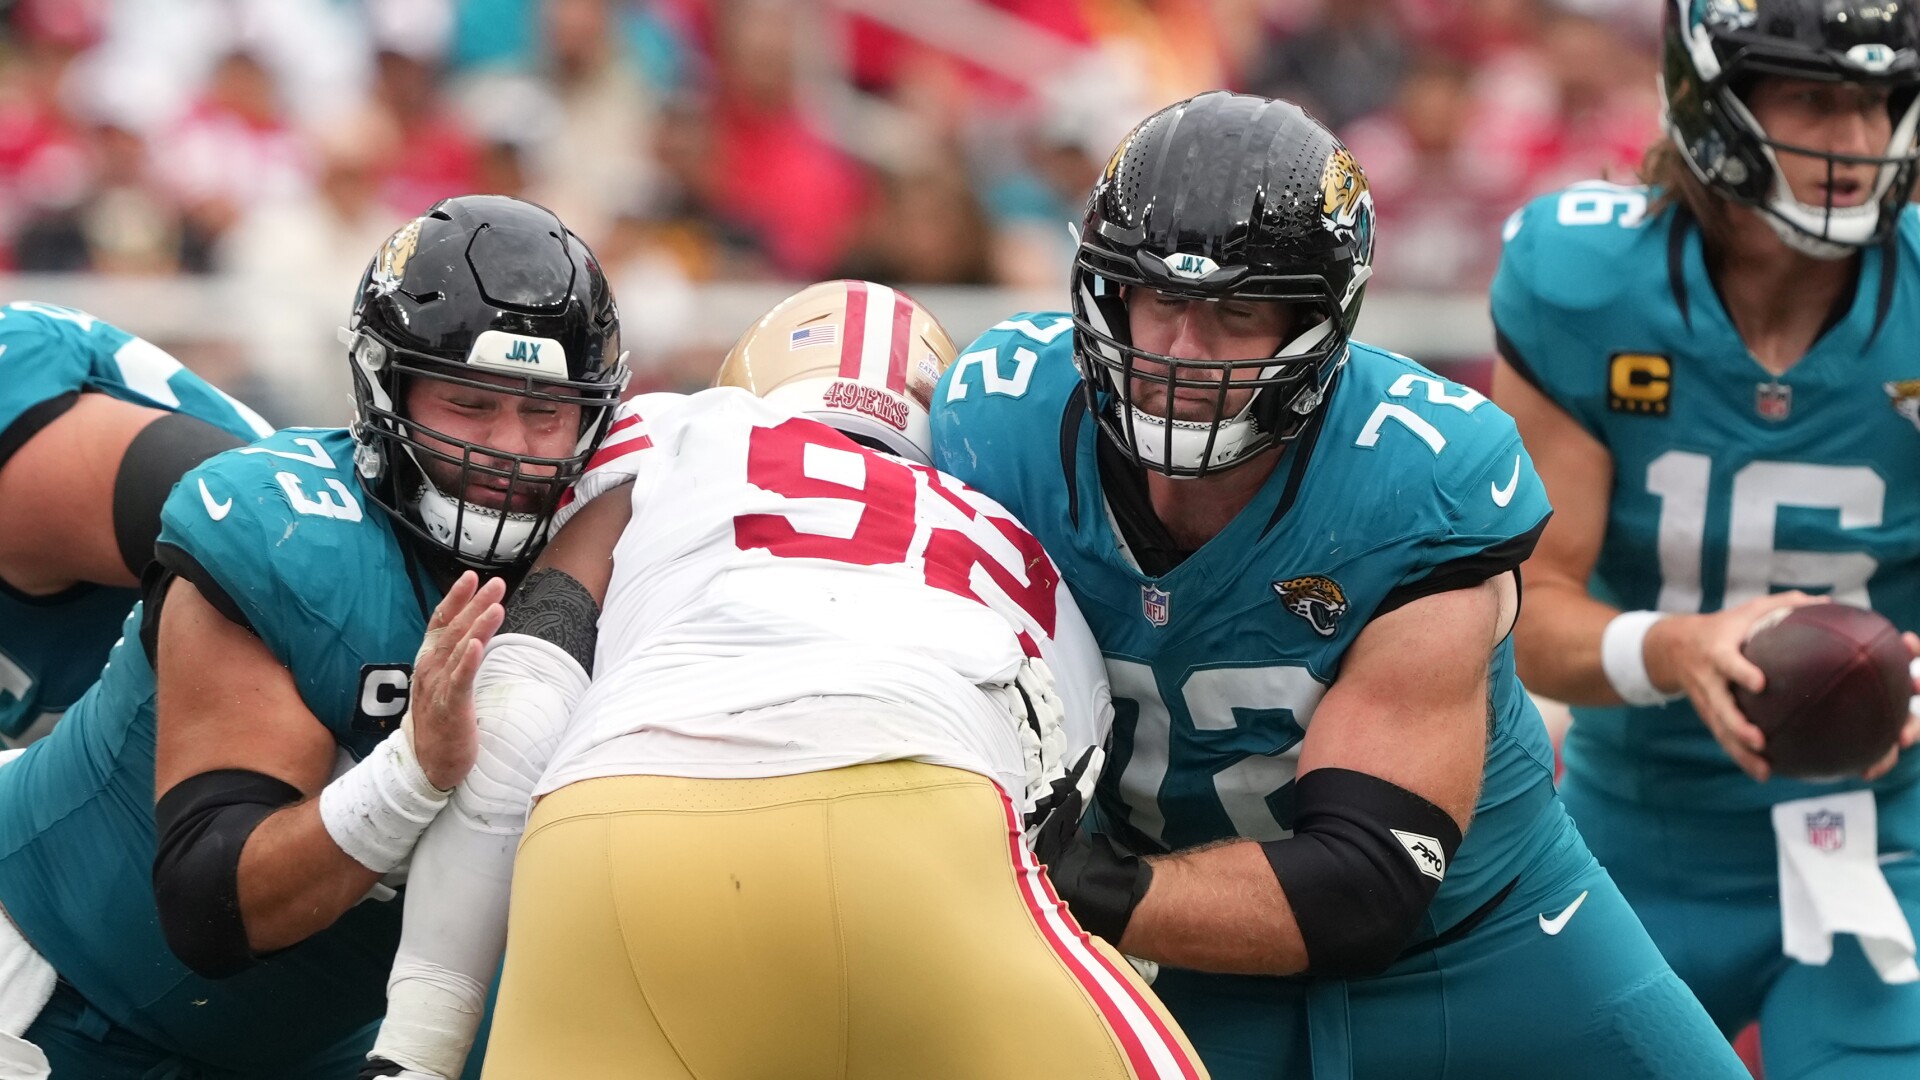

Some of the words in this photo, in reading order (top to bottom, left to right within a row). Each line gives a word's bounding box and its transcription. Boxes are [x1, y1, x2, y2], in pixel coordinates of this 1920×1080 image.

[1176, 255, 1206, 275] JAX
[505, 339, 542, 364] JAX
[946, 317, 1075, 403] 72
[1609, 354, 1671, 401] C
[822, 381, 911, 431] 49ERS
[1357, 372, 1488, 455] 72
[238, 437, 364, 523] 73
[733, 416, 1061, 659] 92
[1645, 450, 1887, 614] 16
[1145, 601, 1164, 621] NFL
[361, 669, 409, 717] C
[1410, 841, 1443, 873] PRO
